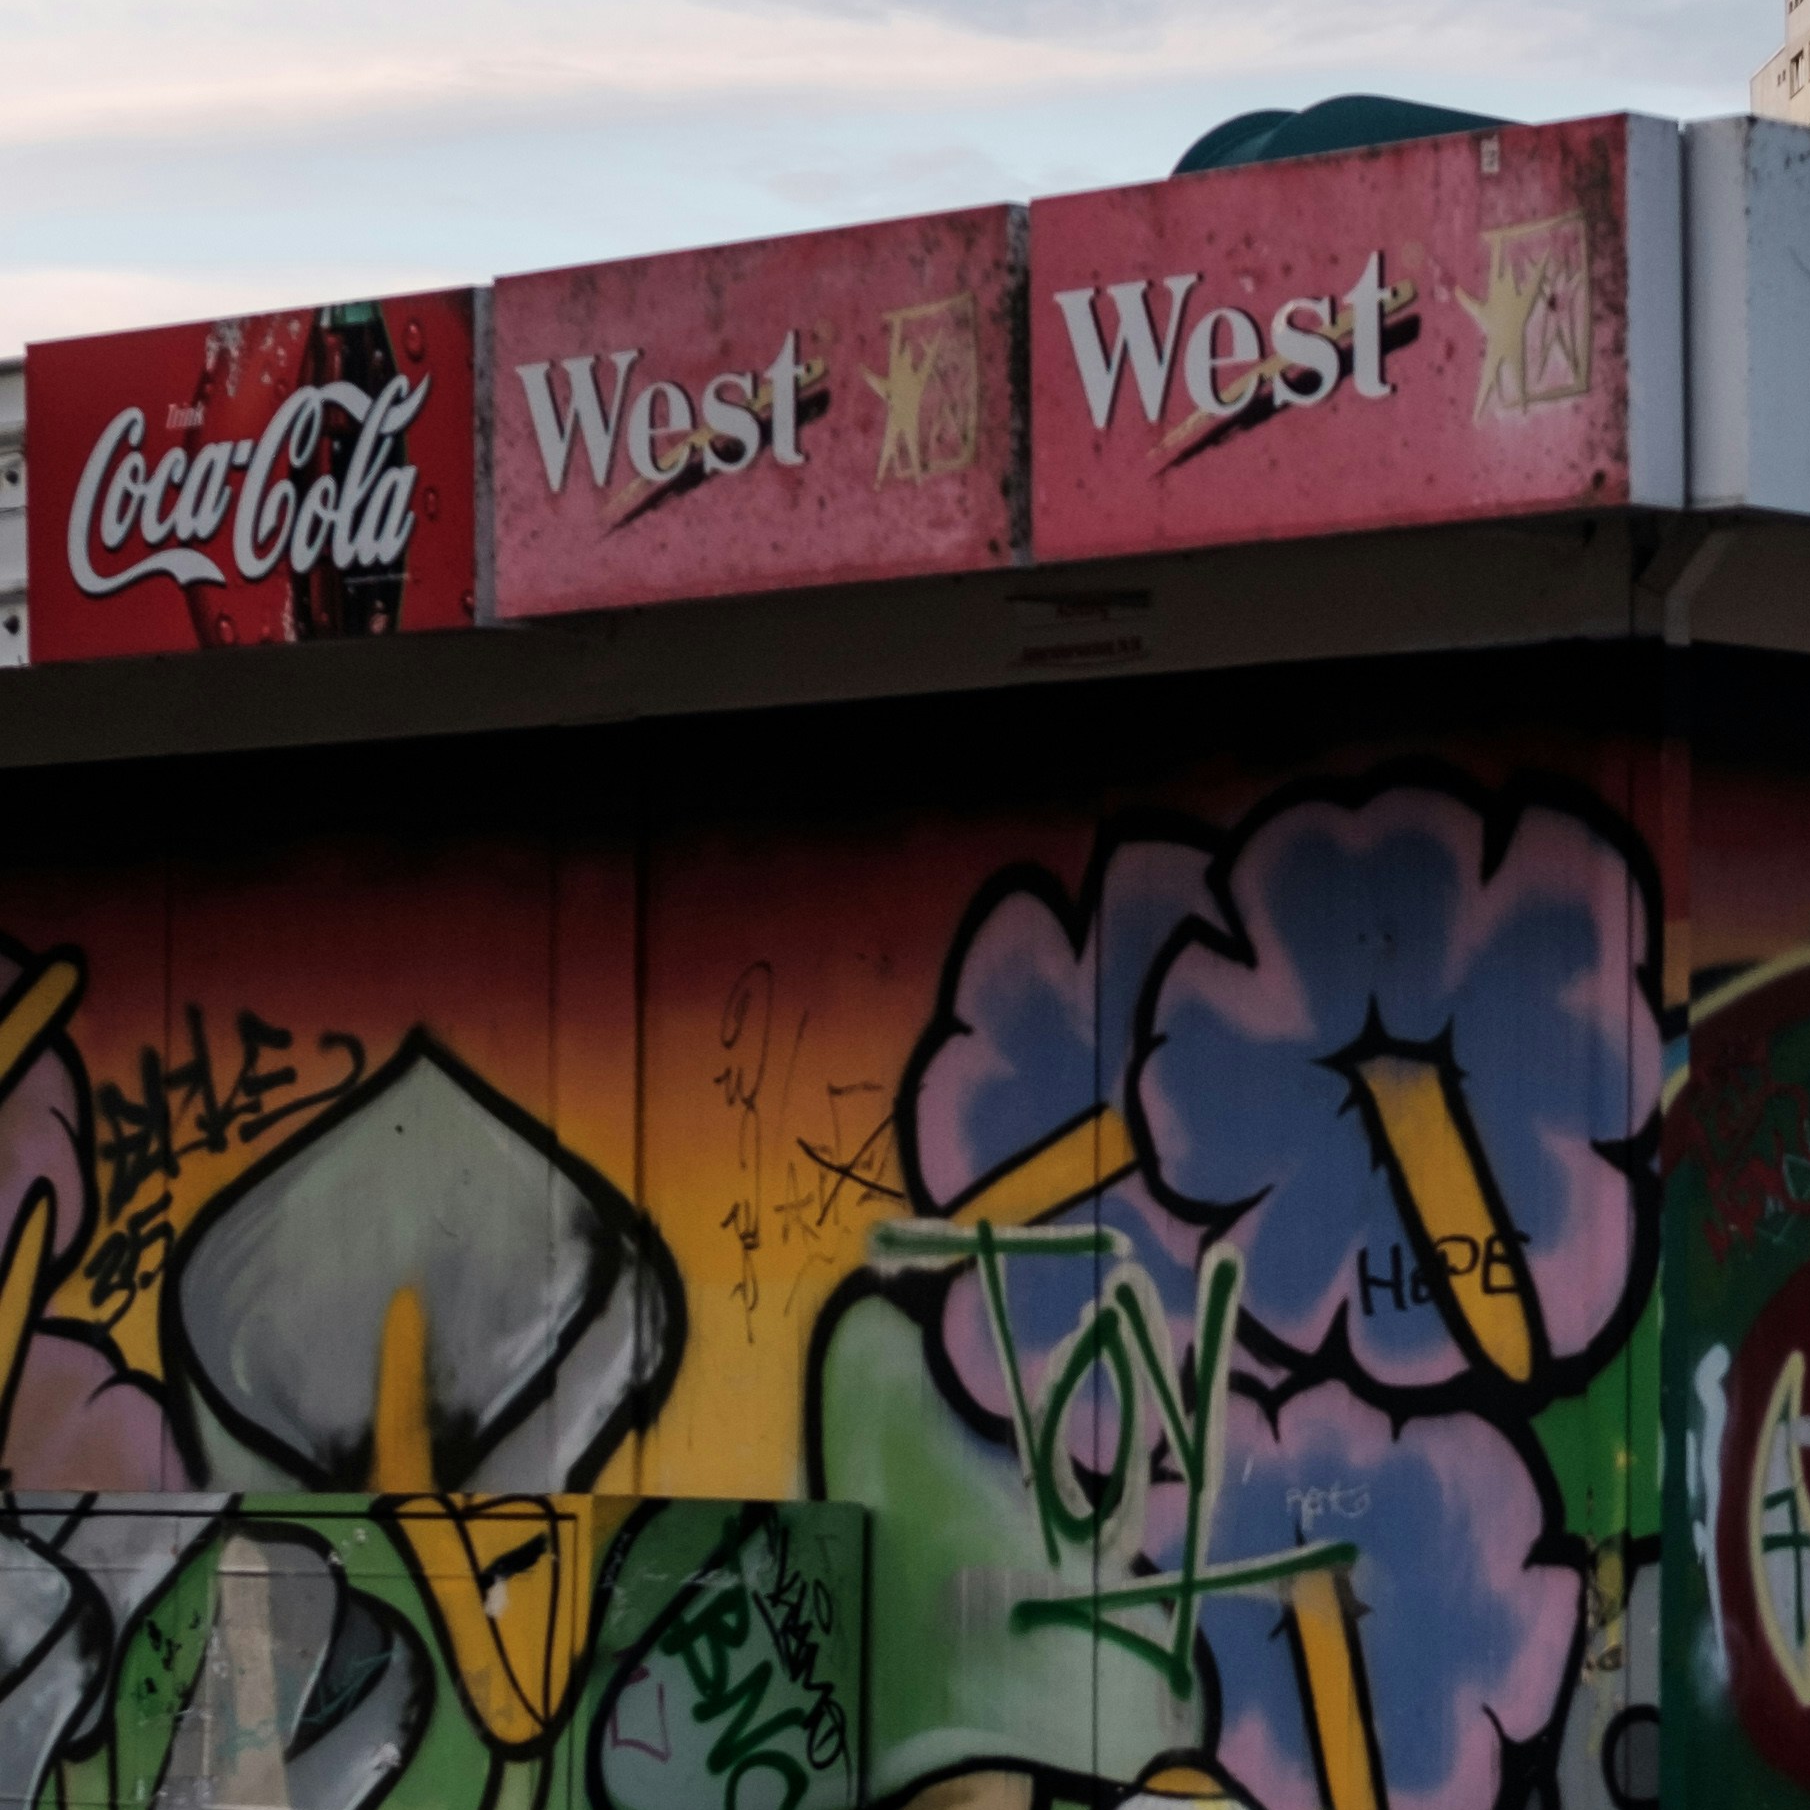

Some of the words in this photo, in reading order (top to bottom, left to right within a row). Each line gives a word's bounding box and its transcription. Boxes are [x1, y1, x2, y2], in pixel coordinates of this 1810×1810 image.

[515, 329, 808, 495] West
[1052, 249, 1396, 431] West
[67, 370, 433, 597] Coca-Cola
